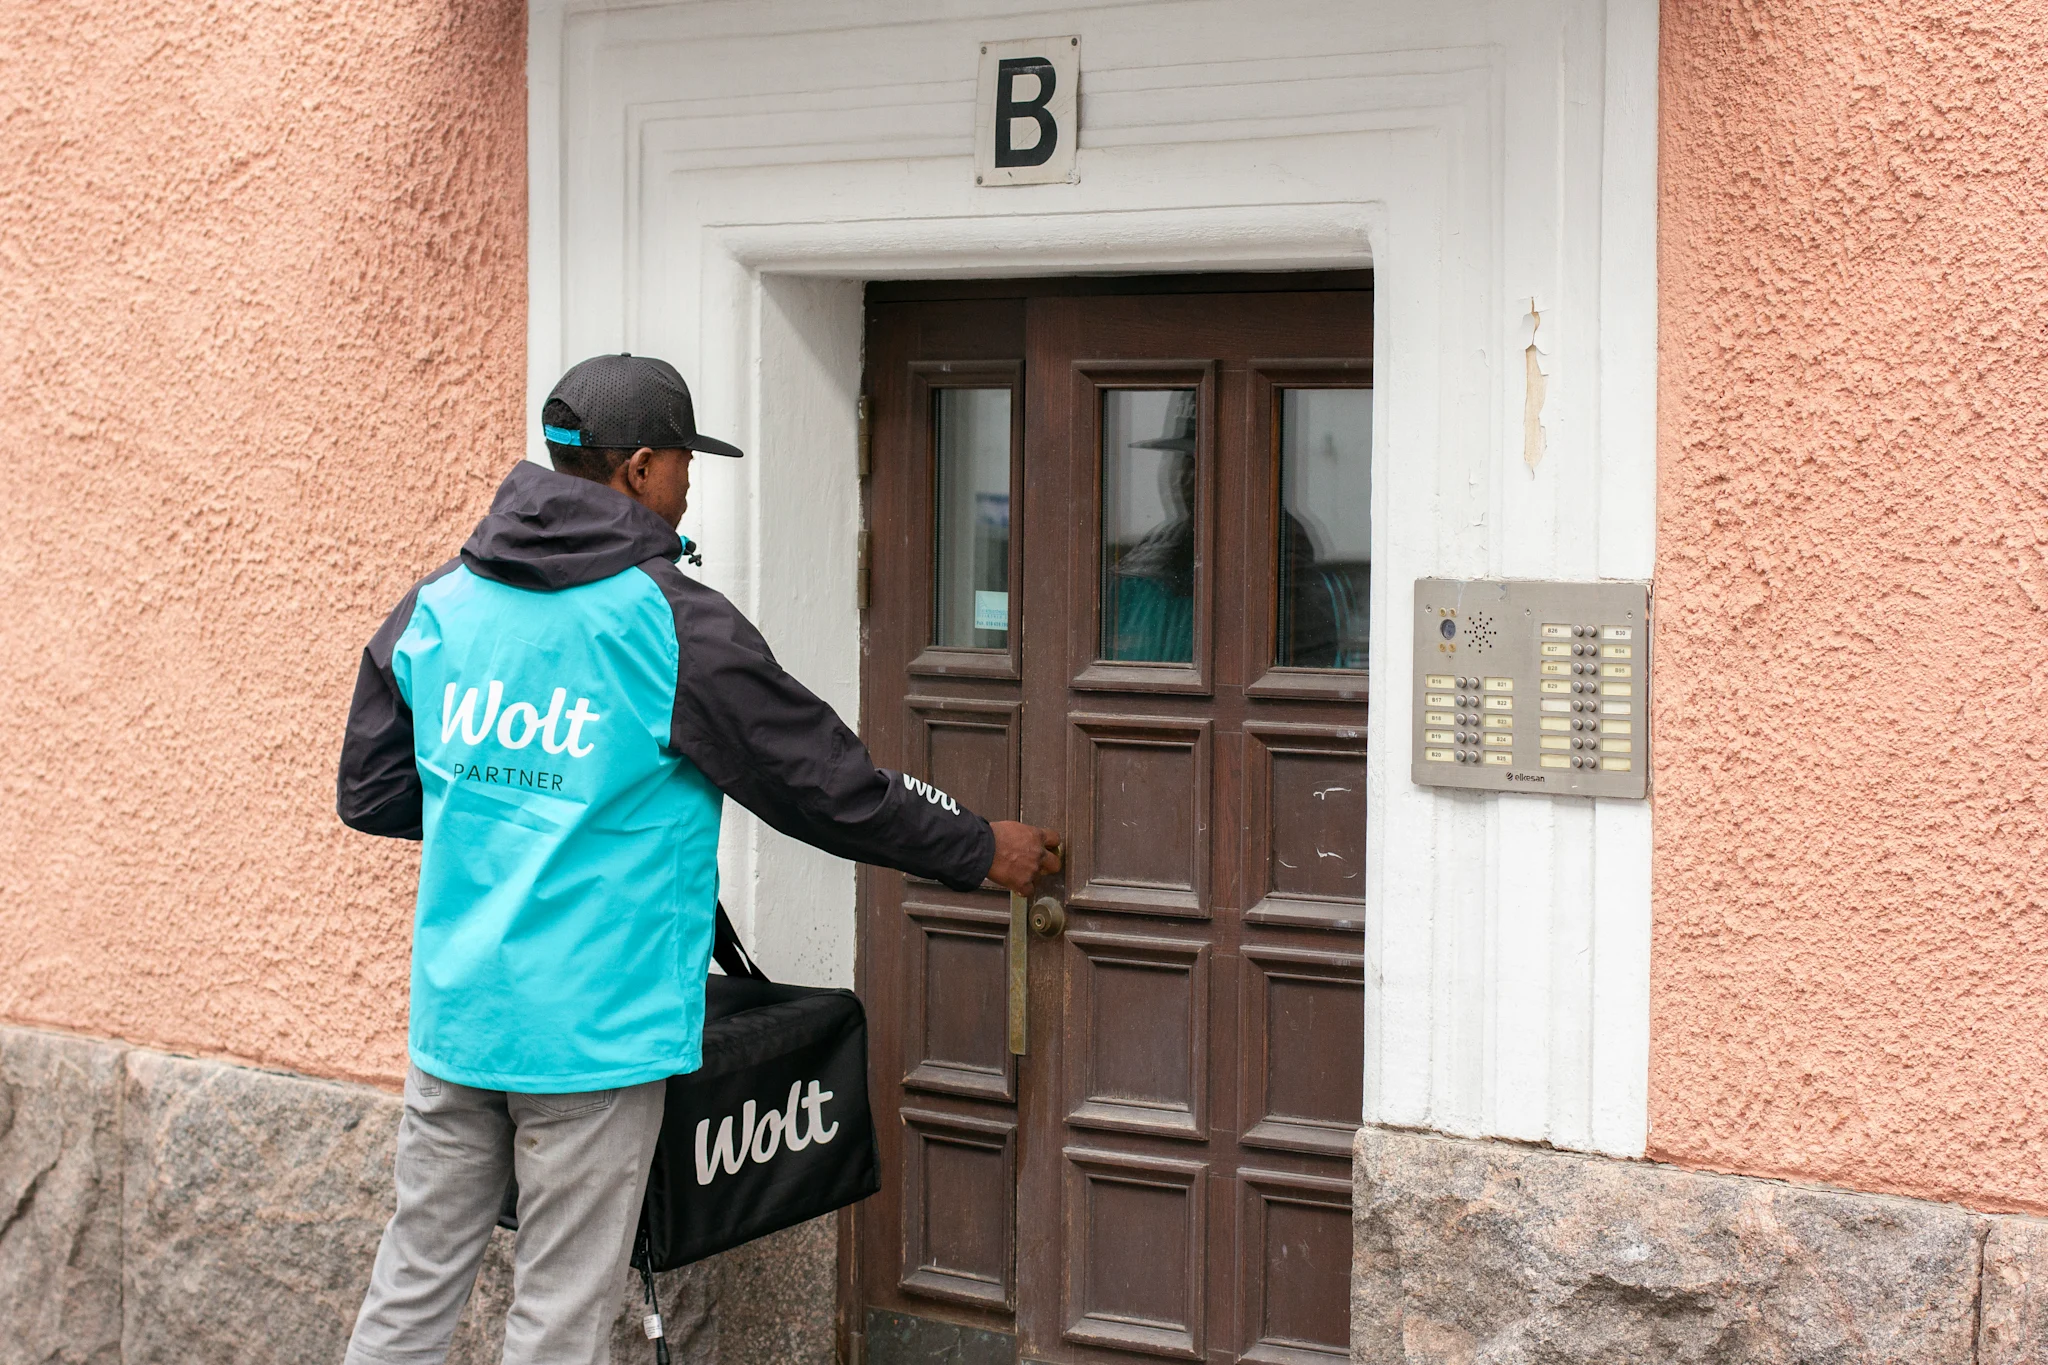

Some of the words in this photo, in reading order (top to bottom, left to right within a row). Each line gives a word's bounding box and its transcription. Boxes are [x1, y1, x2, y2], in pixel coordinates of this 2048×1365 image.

[995, 56, 1058, 168] B
[441, 680, 600, 758] Wolt
[453, 763, 563, 791] PARTNER
[695, 1080, 839, 1186] Wolt
